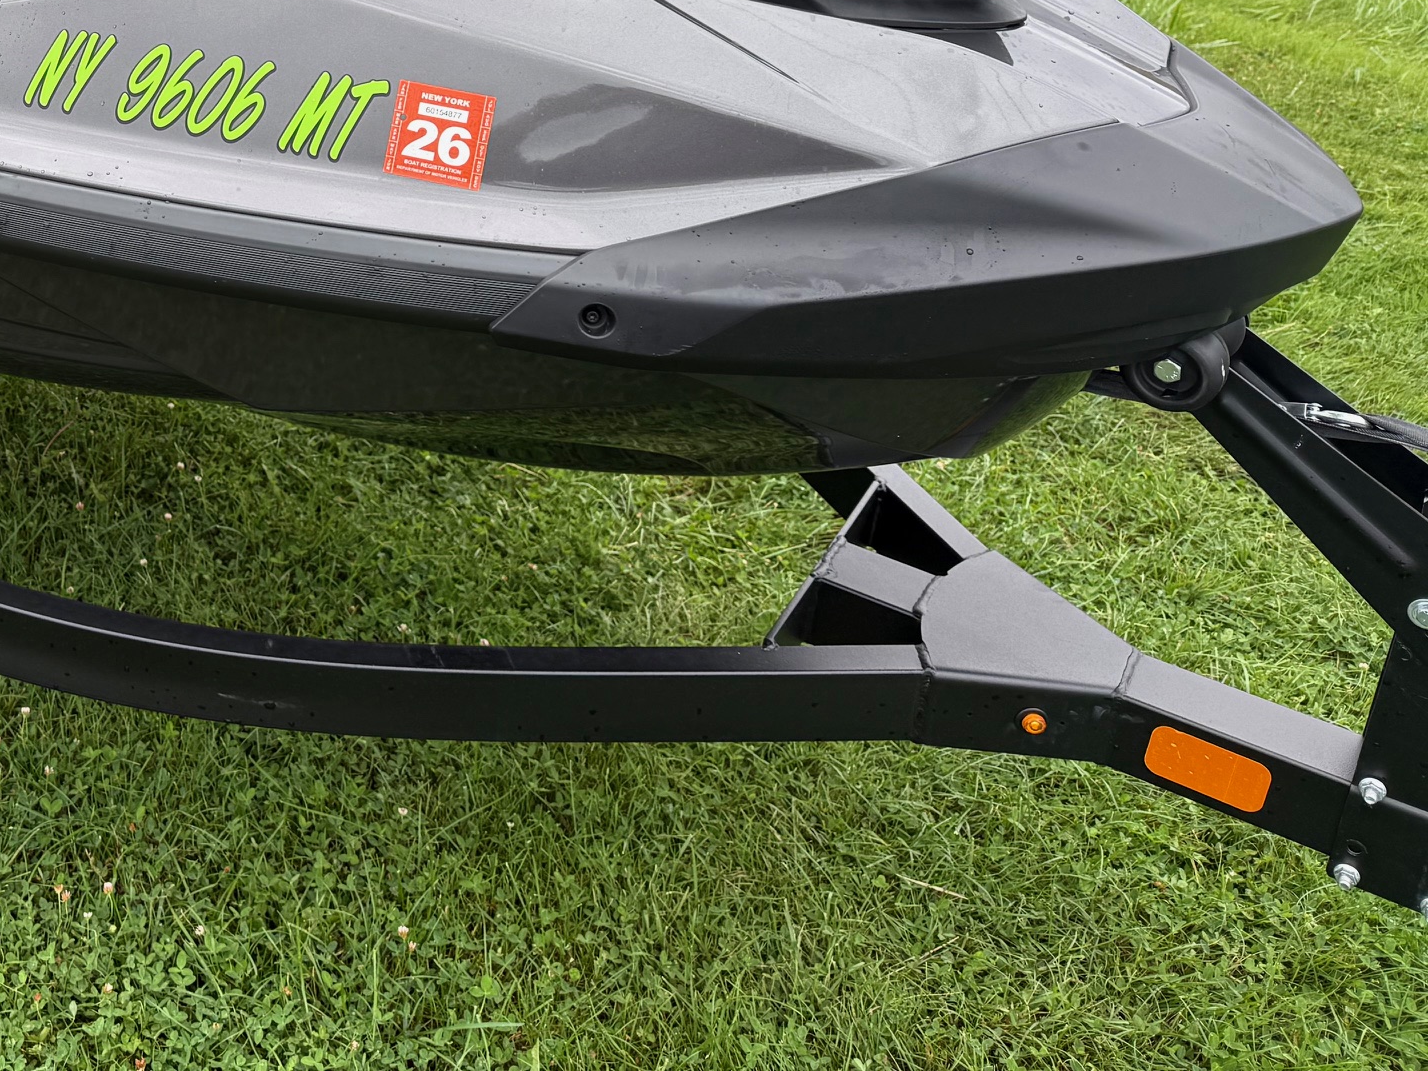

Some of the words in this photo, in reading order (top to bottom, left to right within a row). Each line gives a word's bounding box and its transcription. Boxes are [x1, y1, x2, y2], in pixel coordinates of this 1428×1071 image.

[23, 29, 117, 113] NY
[116, 44, 276, 142] 9606
[277, 71, 391, 162] MT
[421, 92, 443, 102] NEW
[444, 96, 471, 107] YORK
[401, 119, 472, 167] 26
[396, 164, 424, 174] DEPARTMENT
[447, 175, 467, 183] VEHICLES
[403, 158, 419, 167] BOAT
[420, 162, 462, 175] REGISTRATION
